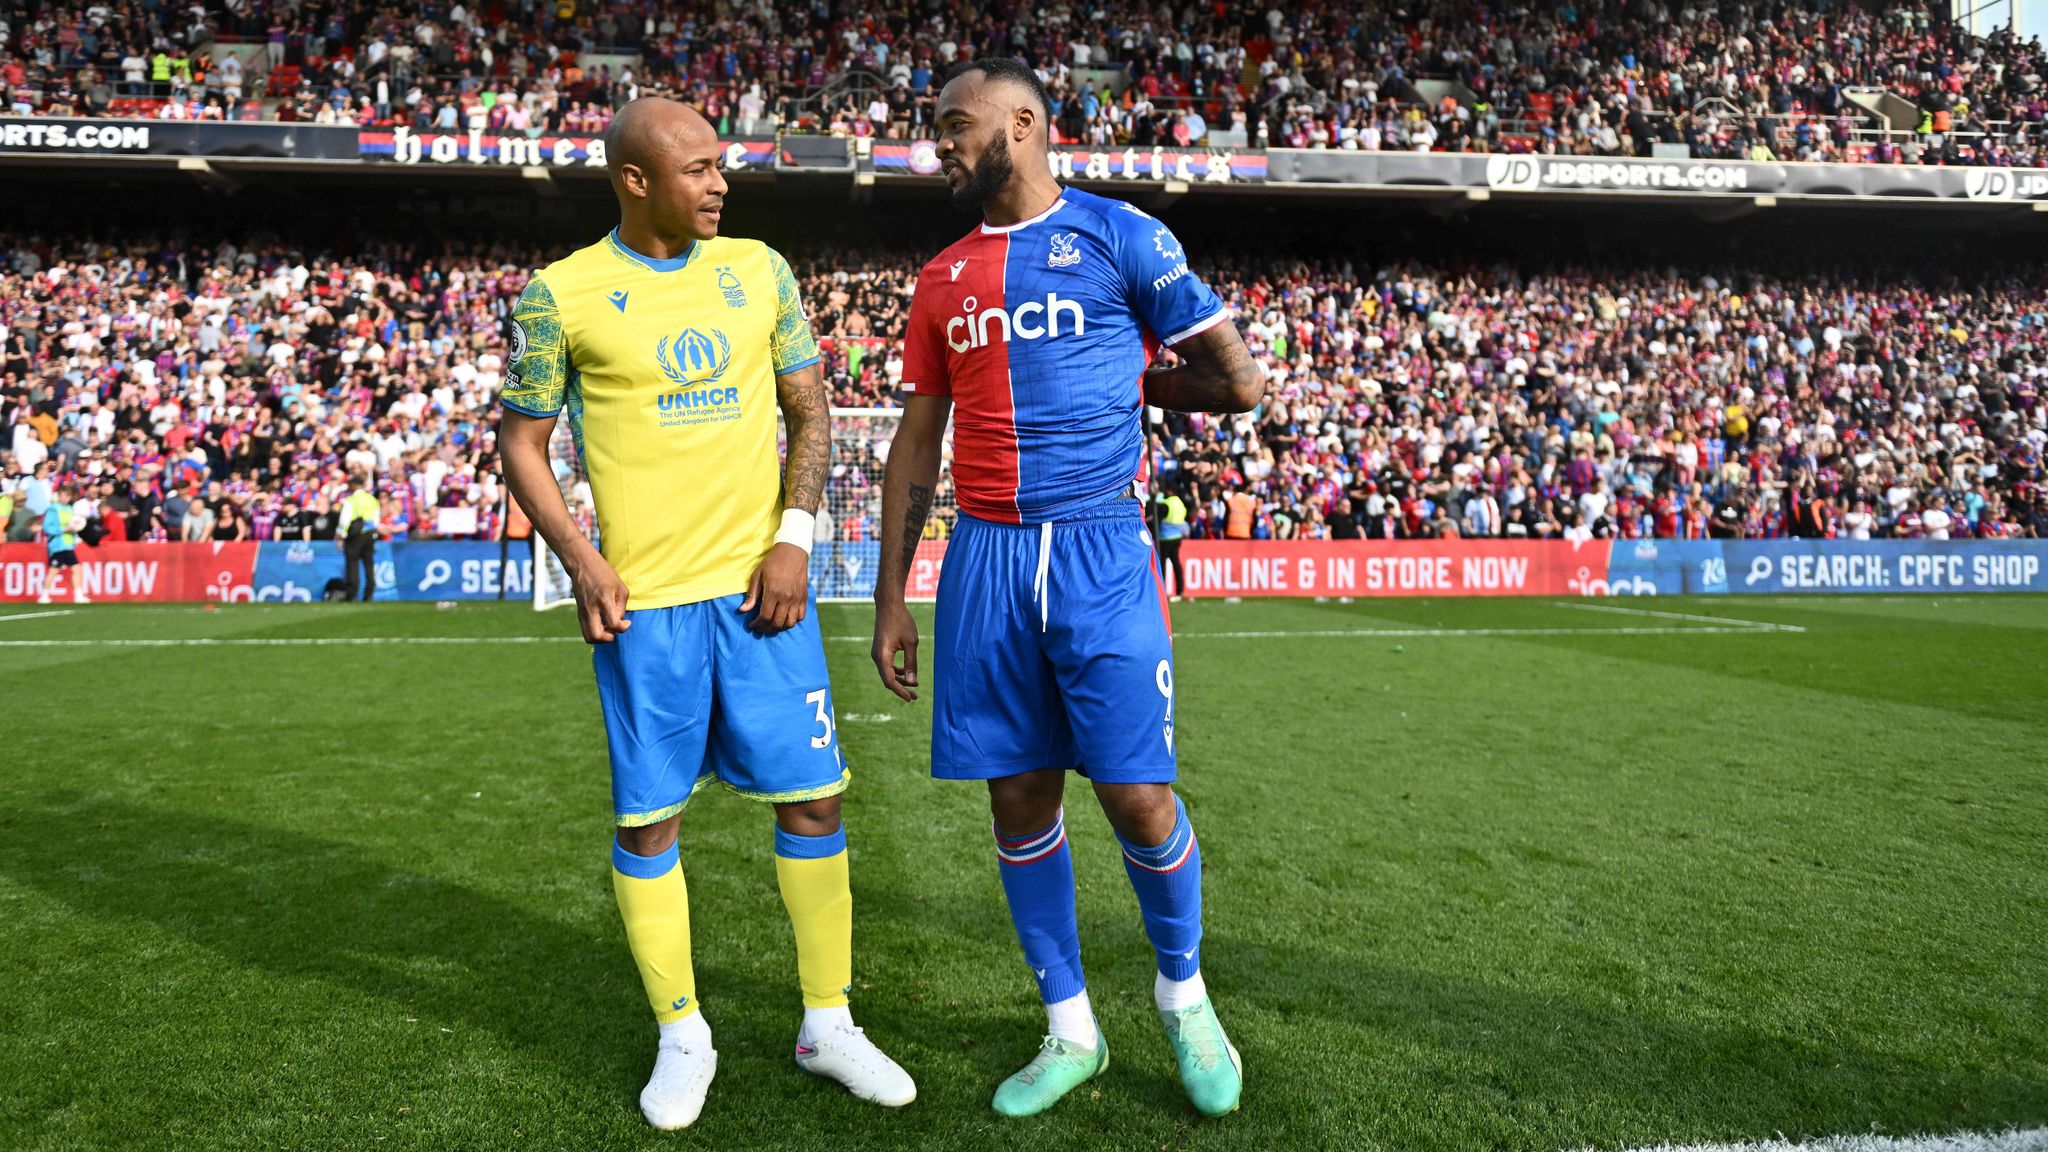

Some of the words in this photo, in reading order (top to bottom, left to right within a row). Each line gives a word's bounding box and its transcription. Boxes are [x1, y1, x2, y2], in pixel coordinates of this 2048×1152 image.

[0, 125, 149, 149] RTS.COM
[393, 126, 748, 170] holmese
[1047, 146, 1232, 183] natics
[1542, 163, 1747, 188] JDSPORTS.COM
[946, 293, 1084, 353] cinch
[657, 387, 739, 410] UNHCR
[716, 406, 741, 414] Agency
[682, 417, 710, 426] Kingdom
[720, 413, 742, 421] UNHCR
[0, 562, 67, 596] ORE
[82, 561, 158, 595] NOW
[1185, 557, 1288, 591] ONLINE
[1299, 557, 1316, 589] &
[1329, 557, 1356, 589] IN
[1366, 557, 1449, 589] STORE
[1463, 556, 1528, 588] NOW
[1781, 554, 1890, 586] SEARCH:
[1899, 555, 1963, 586] CPFC
[1973, 555, 2039, 586] SHOP
[1155, 658, 1173, 722] 9
[805, 688, 836, 749] 3
